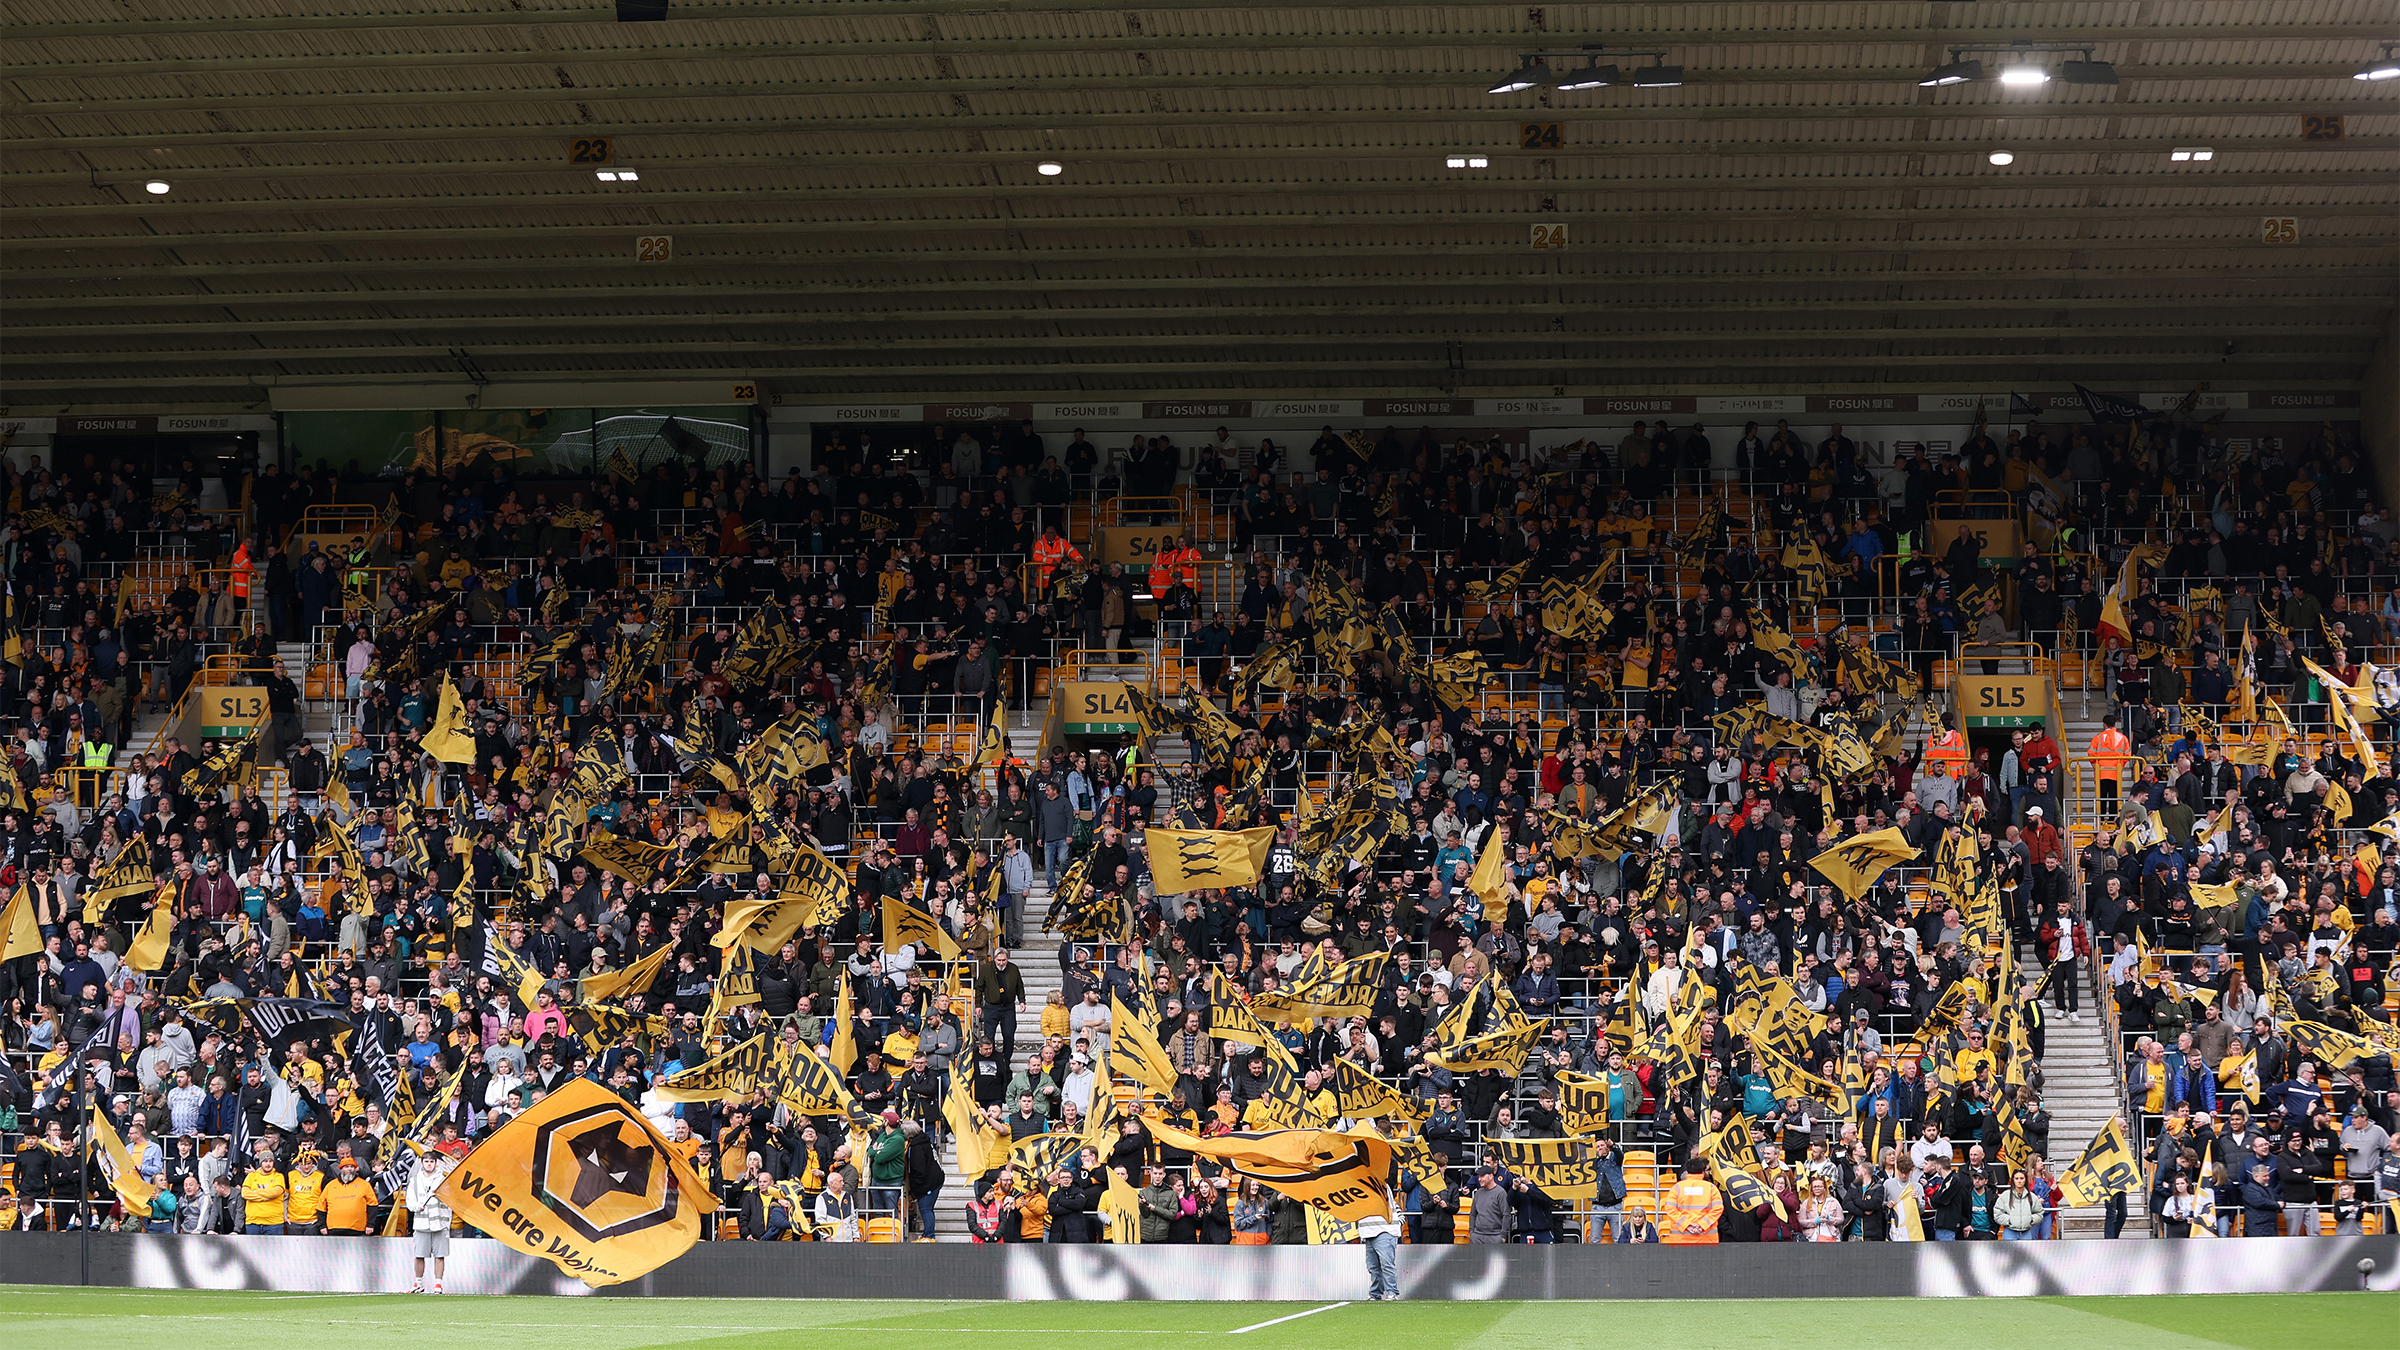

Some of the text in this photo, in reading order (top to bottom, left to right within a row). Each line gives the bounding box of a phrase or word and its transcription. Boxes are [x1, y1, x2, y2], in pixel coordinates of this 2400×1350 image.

[2306, 117, 2341, 139] 25
[1524, 124, 1560, 148] 24
[573, 139, 607, 162] 23
[1533, 225, 1565, 248] 24
[2264, 218, 2296, 242] 25
[639, 238, 669, 261] 23
[734, 386, 755, 399] 23
[1554, 387, 1564, 396] 24
[772, 396, 782, 404] 23
[1607, 402, 1648, 410] FOSUN
[1828, 400, 1870, 408] FOSUN
[1941, 398, 1983, 408] FOSU
[2050, 397, 2086, 406] FOSU
[2270, 396, 2312, 405] FOSUN
[836, 410, 876, 418] FOSUN
[946, 408, 984, 418] FOSUN
[1055, 408, 1096, 416] FOSUN
[1165, 406, 1206, 415] FOSUN
[1275, 404, 1316, 414] FOSUN
[1386, 404, 1426, 412] FOSUN
[77, 421, 115, 430] FOSUN
[169, 420, 207, 428] FOSUN
[326, 544, 350, 557] S3
[1130, 537, 1157, 556] S4
[1084, 694, 1129, 714] SL4
[1980, 687, 2025, 708] SL5
[220, 698, 262, 718] SL3
[1272, 854, 1294, 874] 26
[794, 853, 846, 896] OUT
[2101, 1162, 2138, 1190] OF
[1328, 1187, 1369, 1207] are
[460, 1170, 502, 1212] We
[502, 1207, 544, 1246] are
